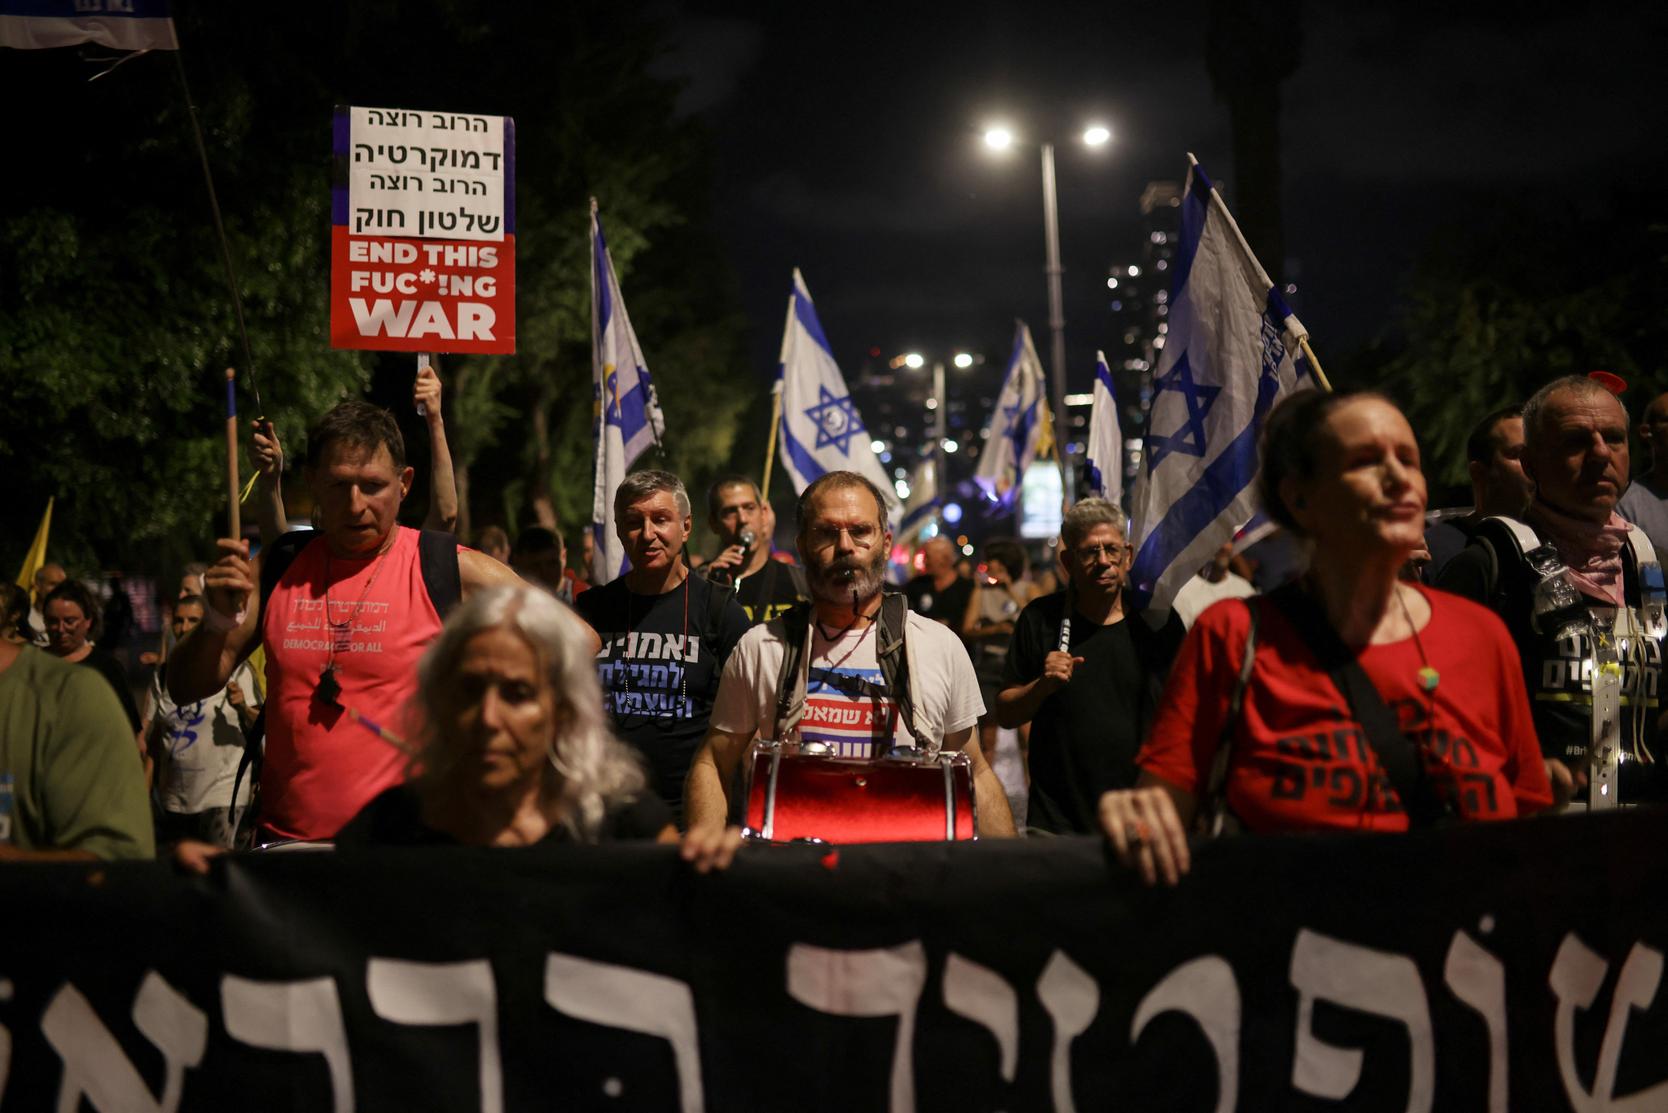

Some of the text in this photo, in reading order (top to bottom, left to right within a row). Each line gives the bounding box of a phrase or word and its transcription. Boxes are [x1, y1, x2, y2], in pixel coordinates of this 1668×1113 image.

[368, 110, 488, 133] הרוב רוצה
[354, 143, 501, 173] דמוקרטיה
[370, 174, 487, 196] הרוב רוצה
[356, 207, 500, 236] שלטון חוק
[349, 240, 499, 268] END THIS
[348, 297, 497, 341] WAR
[366, 641, 383, 653] ALL
